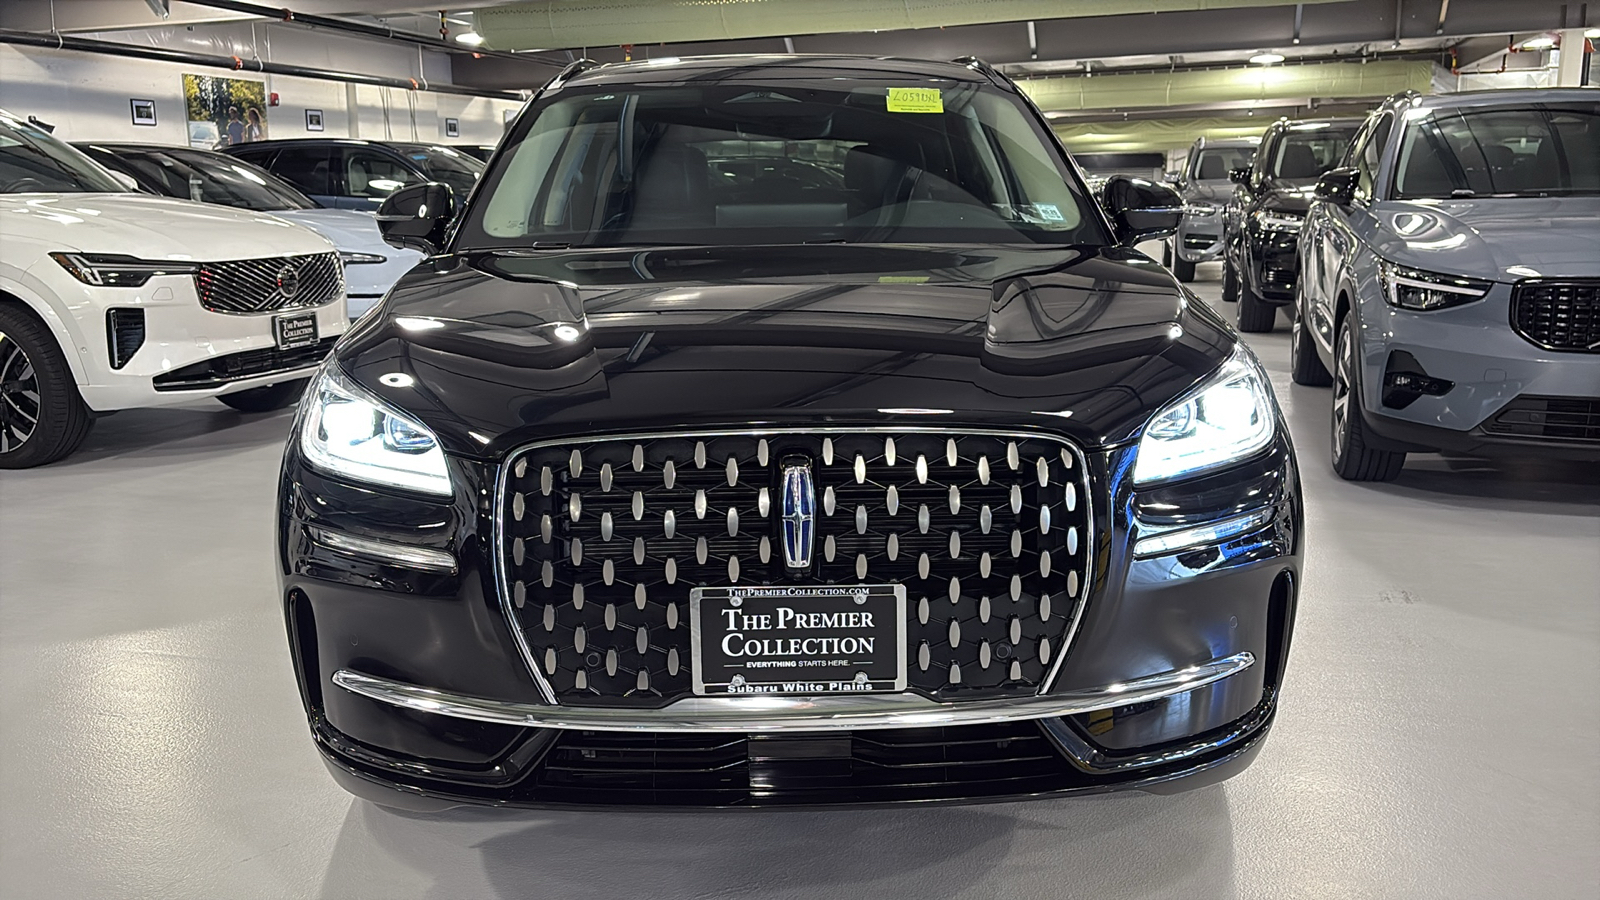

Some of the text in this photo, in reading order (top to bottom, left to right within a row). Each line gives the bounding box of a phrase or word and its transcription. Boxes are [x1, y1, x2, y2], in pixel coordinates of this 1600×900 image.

[721, 607, 876, 631] THE PREMIER
[721, 632, 875, 657] COLLECTION
[828, 659, 850, 667] HERE.
[727, 682, 873, 693] Subaru White Plains
